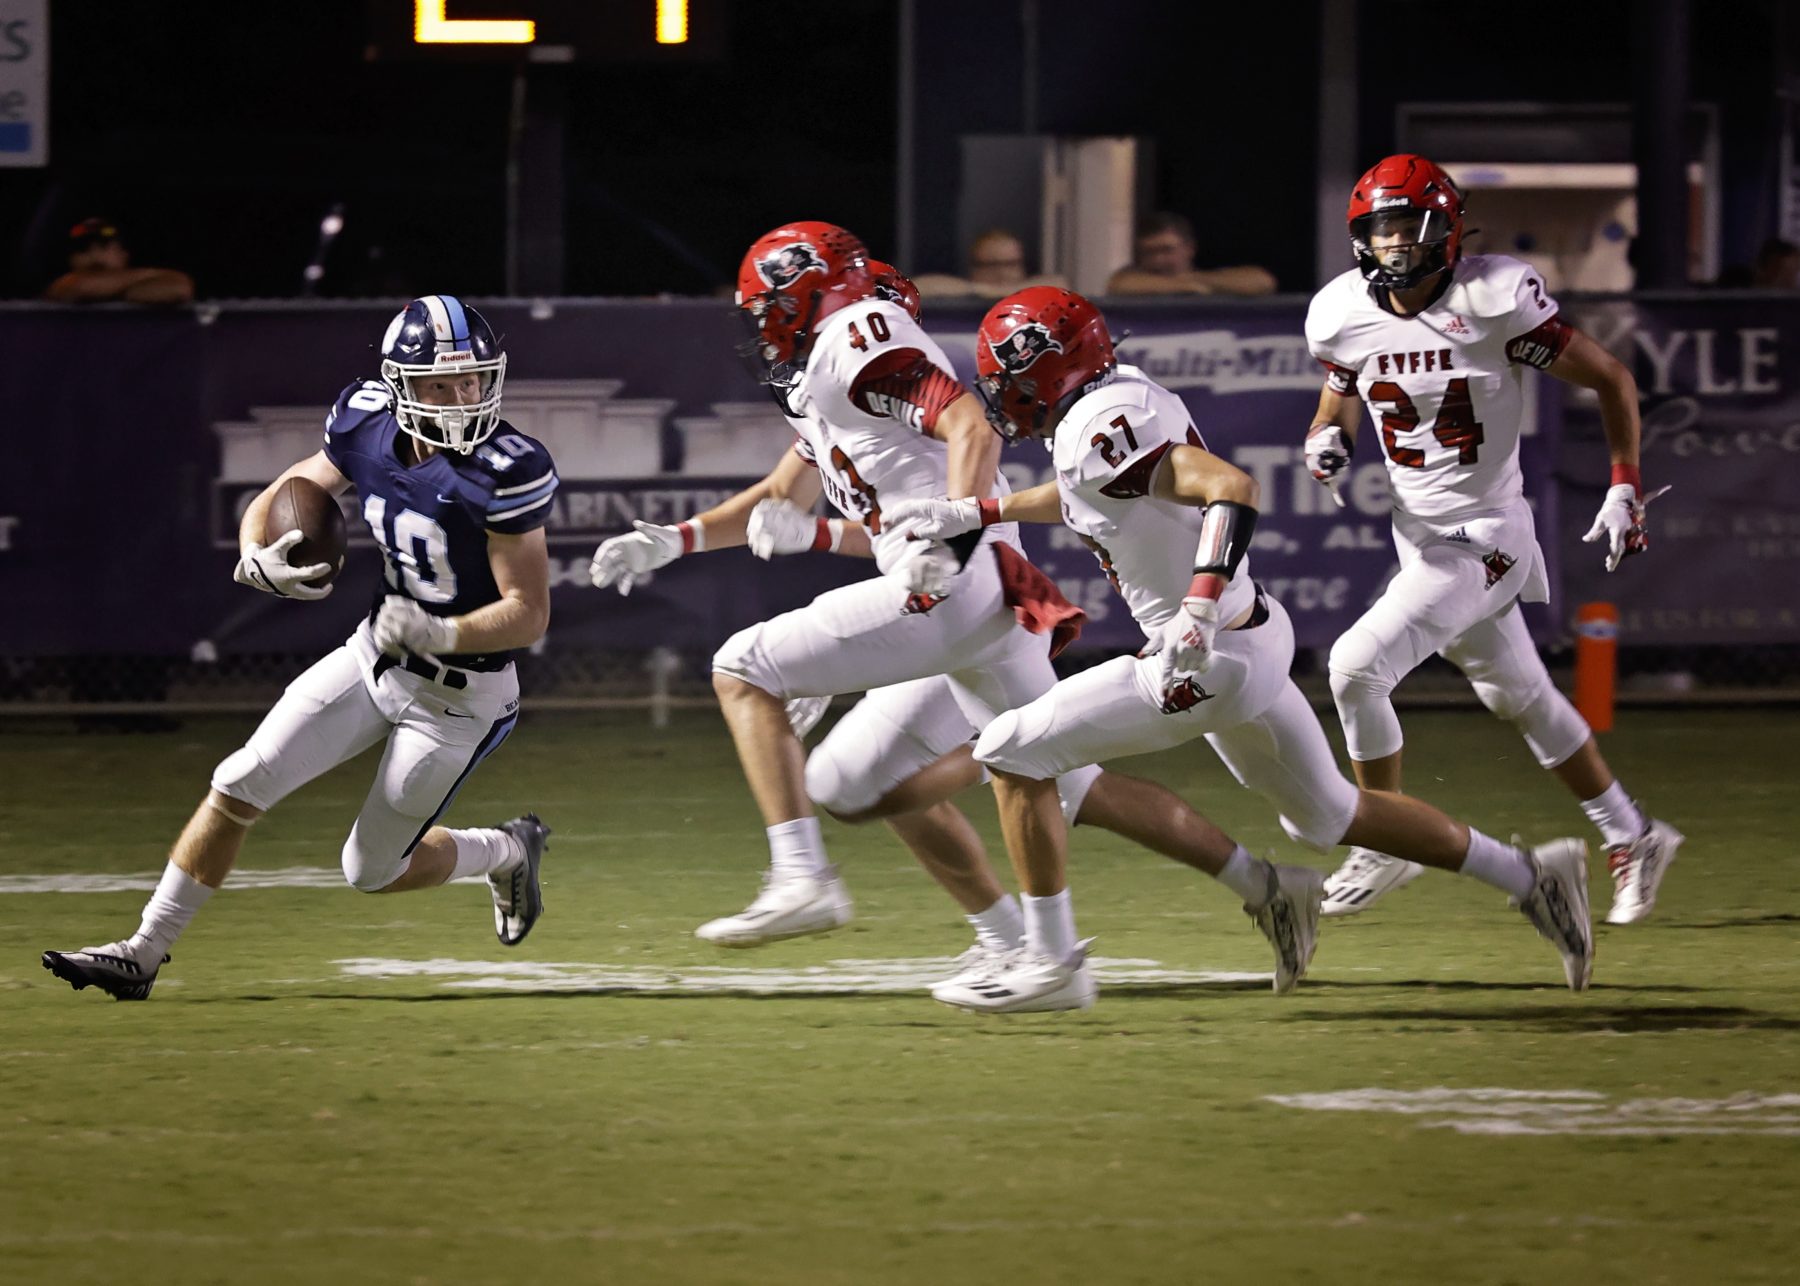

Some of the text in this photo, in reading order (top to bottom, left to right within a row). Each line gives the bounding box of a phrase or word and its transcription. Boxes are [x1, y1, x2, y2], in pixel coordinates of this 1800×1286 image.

[848, 311, 891, 352] 40
[1377, 349, 1454, 375] FYFFE
[1090, 413, 1139, 469] 27
[1367, 377, 1485, 468] 24
[477, 434, 536, 472] 10
[363, 493, 458, 604] 10
